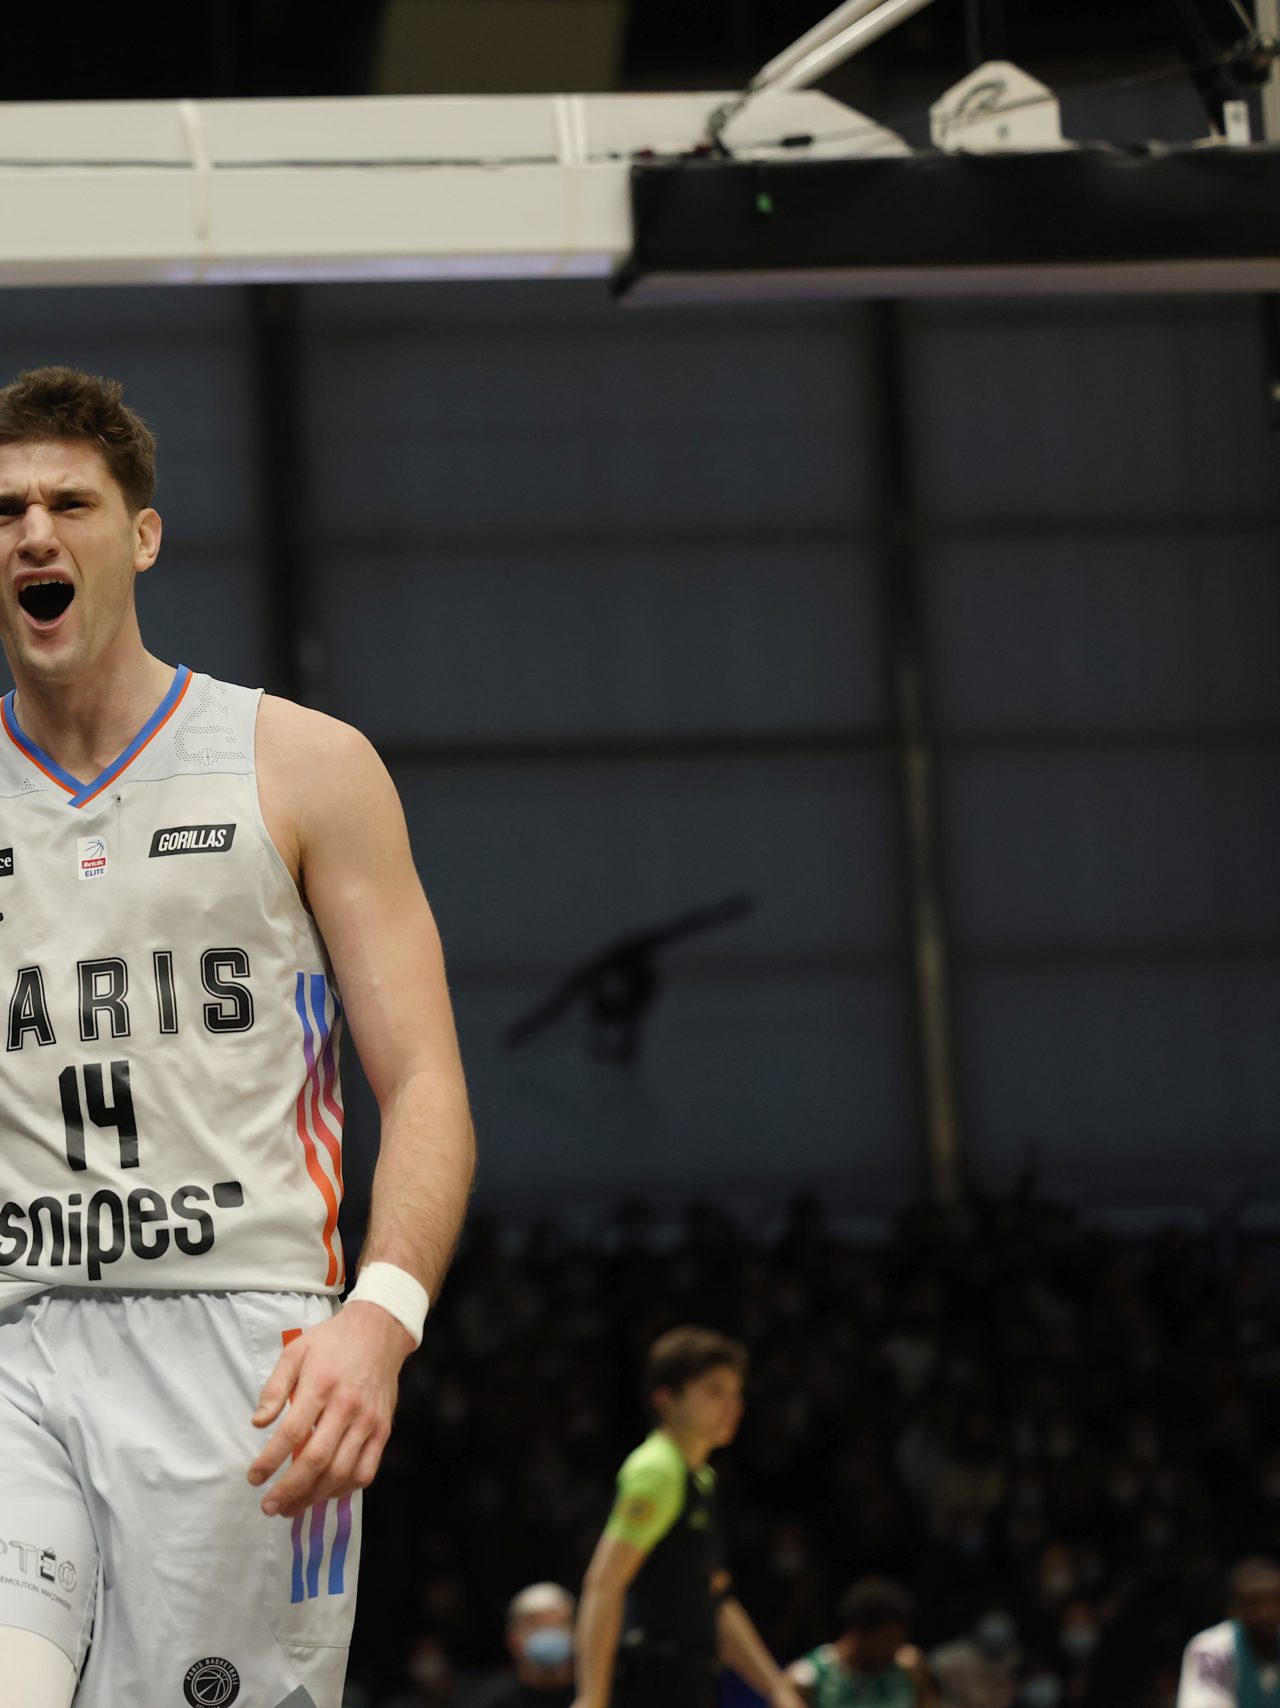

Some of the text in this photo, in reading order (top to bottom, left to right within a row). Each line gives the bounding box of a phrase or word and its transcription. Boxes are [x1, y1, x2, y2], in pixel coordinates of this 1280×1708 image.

[158, 829, 227, 852] GORILLAS
[58, 1060, 140, 1171] 14
[185, 1658, 239, 1686] PARIS BASKETBALL
